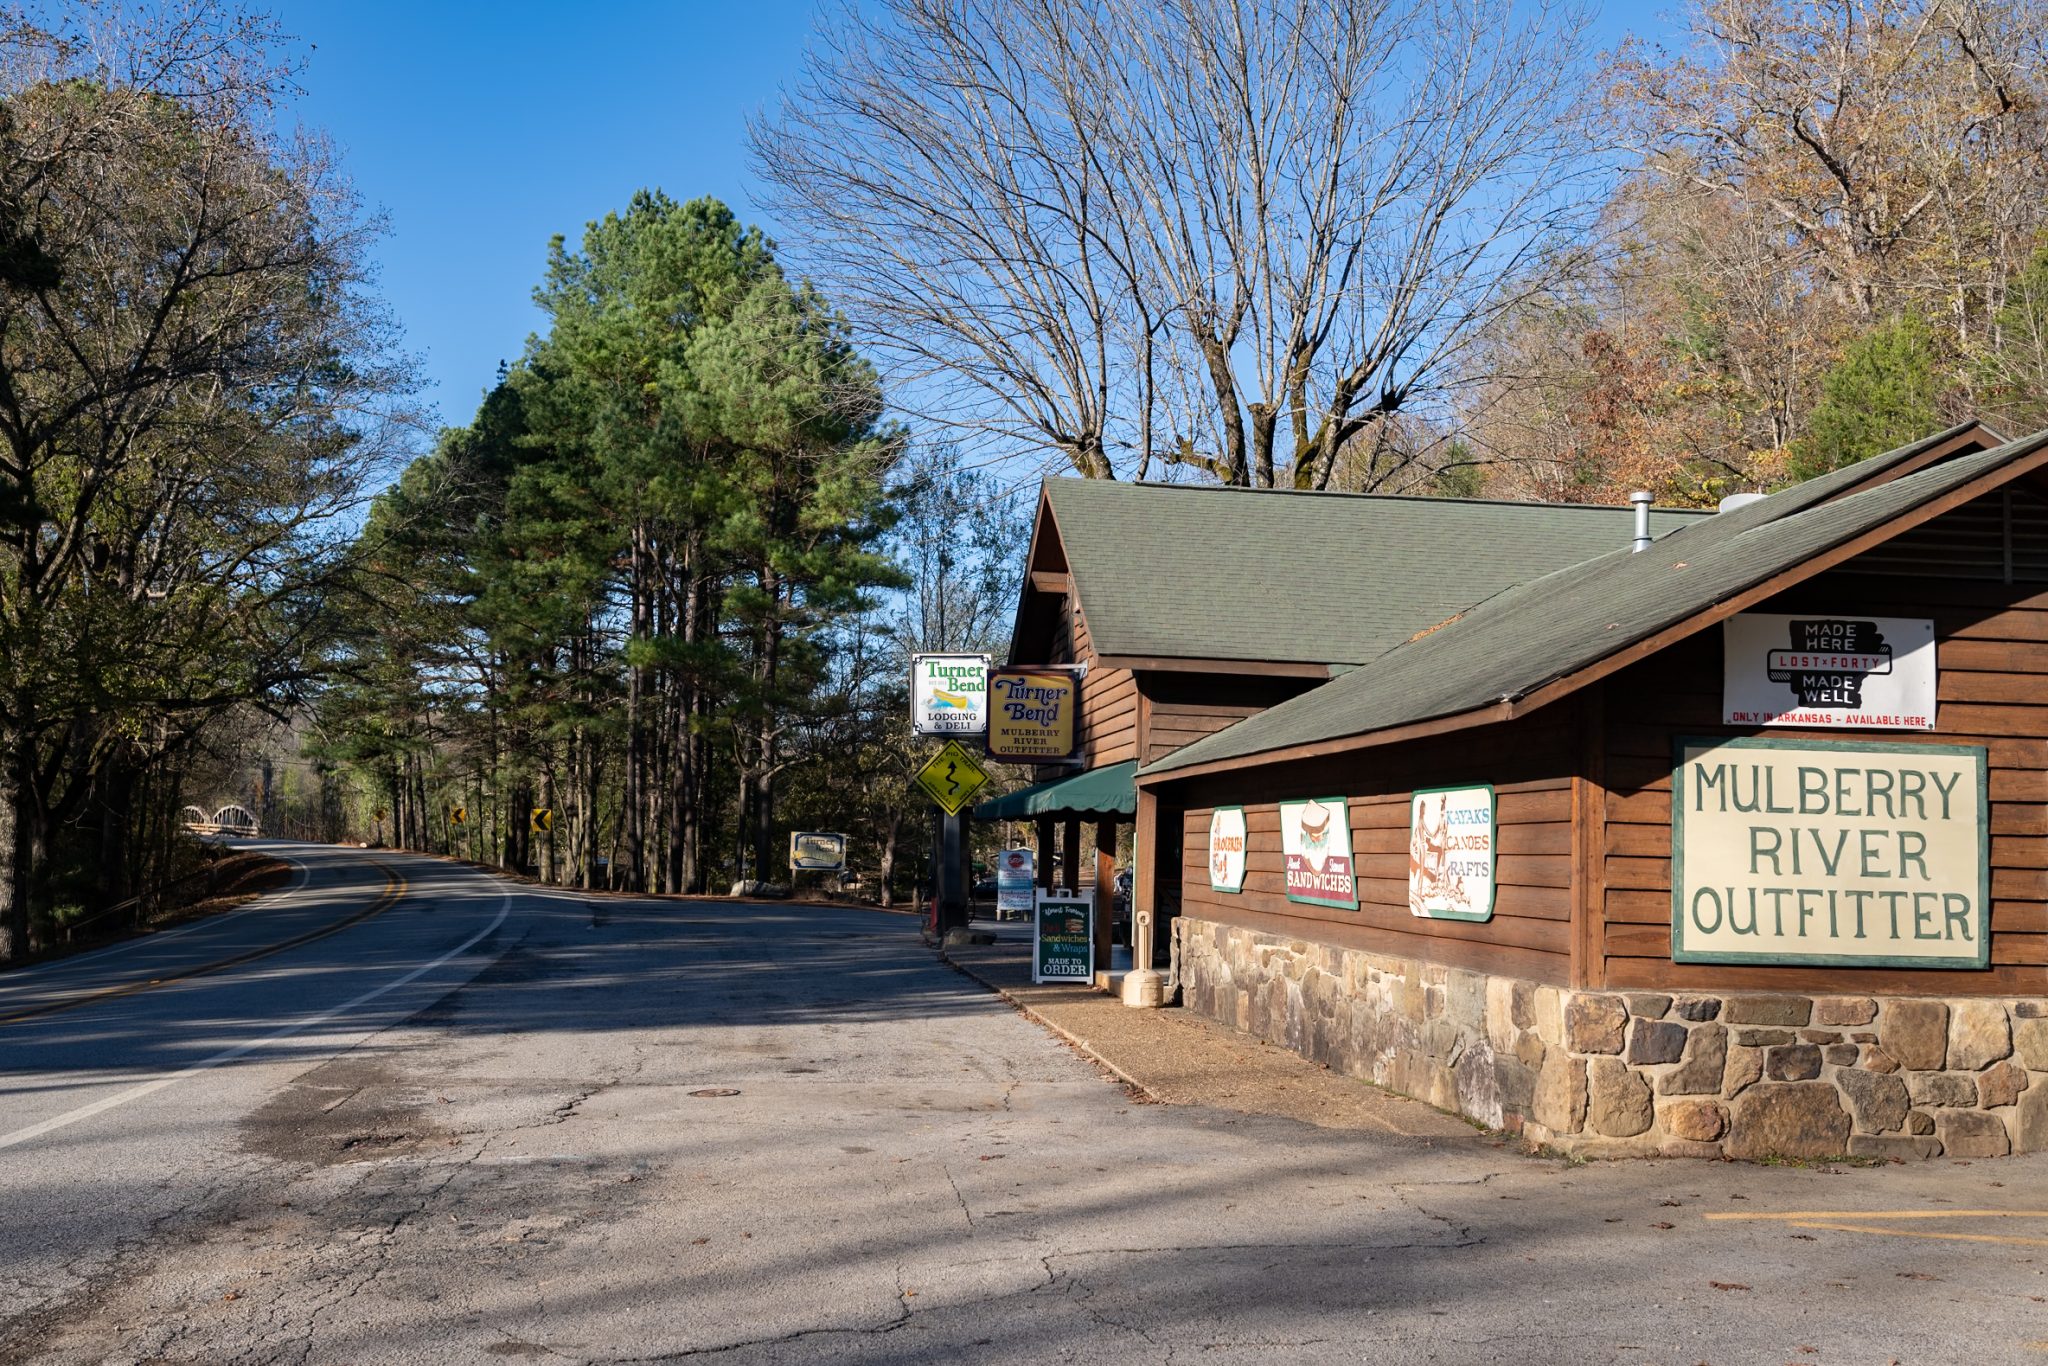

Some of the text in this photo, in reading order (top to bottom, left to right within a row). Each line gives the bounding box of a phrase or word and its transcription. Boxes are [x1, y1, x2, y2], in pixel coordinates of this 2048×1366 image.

[1806, 624, 1857, 637] MADE
[1806, 637, 1855, 651] HERE
[925, 661, 984, 678] Turner
[947, 676, 986, 692] Bend
[1803, 675, 1855, 690] MADE
[995, 677, 1068, 706] Turner
[1804, 690, 1853, 704] WELL
[928, 713, 977, 721] LODGING
[1004, 703, 1059, 727] Bend
[1733, 711, 1759, 722] ONLY
[1763, 712, 1773, 722] IN
[1778, 712, 1832, 724] ARKANSAS
[1846, 714, 1901, 726] AVAILABLE
[1904, 716, 1926, 727] HERE
[934, 722, 971, 730] & DELI
[1001, 728, 1060, 737] MULBERRY
[1013, 737, 1047, 745] RIVER
[1000, 746, 1061, 754] OUTFITTER
[932, 757, 944, 769] THE
[960, 756, 976, 774] TRAIL
[1694, 762, 1962, 820] MULBERRY
[1446, 808, 1490, 825] KAYAKS
[1213, 836, 1243, 852] GROCERIES
[1447, 835, 1489, 851] CANOES
[1748, 826, 1932, 882] RIVER
[1450, 861, 1489, 878] RAFTS
[1287, 870, 1352, 894] SANDWICHES
[1692, 886, 1975, 942] OUTFITTER
[1041, 934, 1088, 943] Sandwiches
[1053, 944, 1088, 954] & Wraps
[1043, 965, 1087, 975] ORDER
